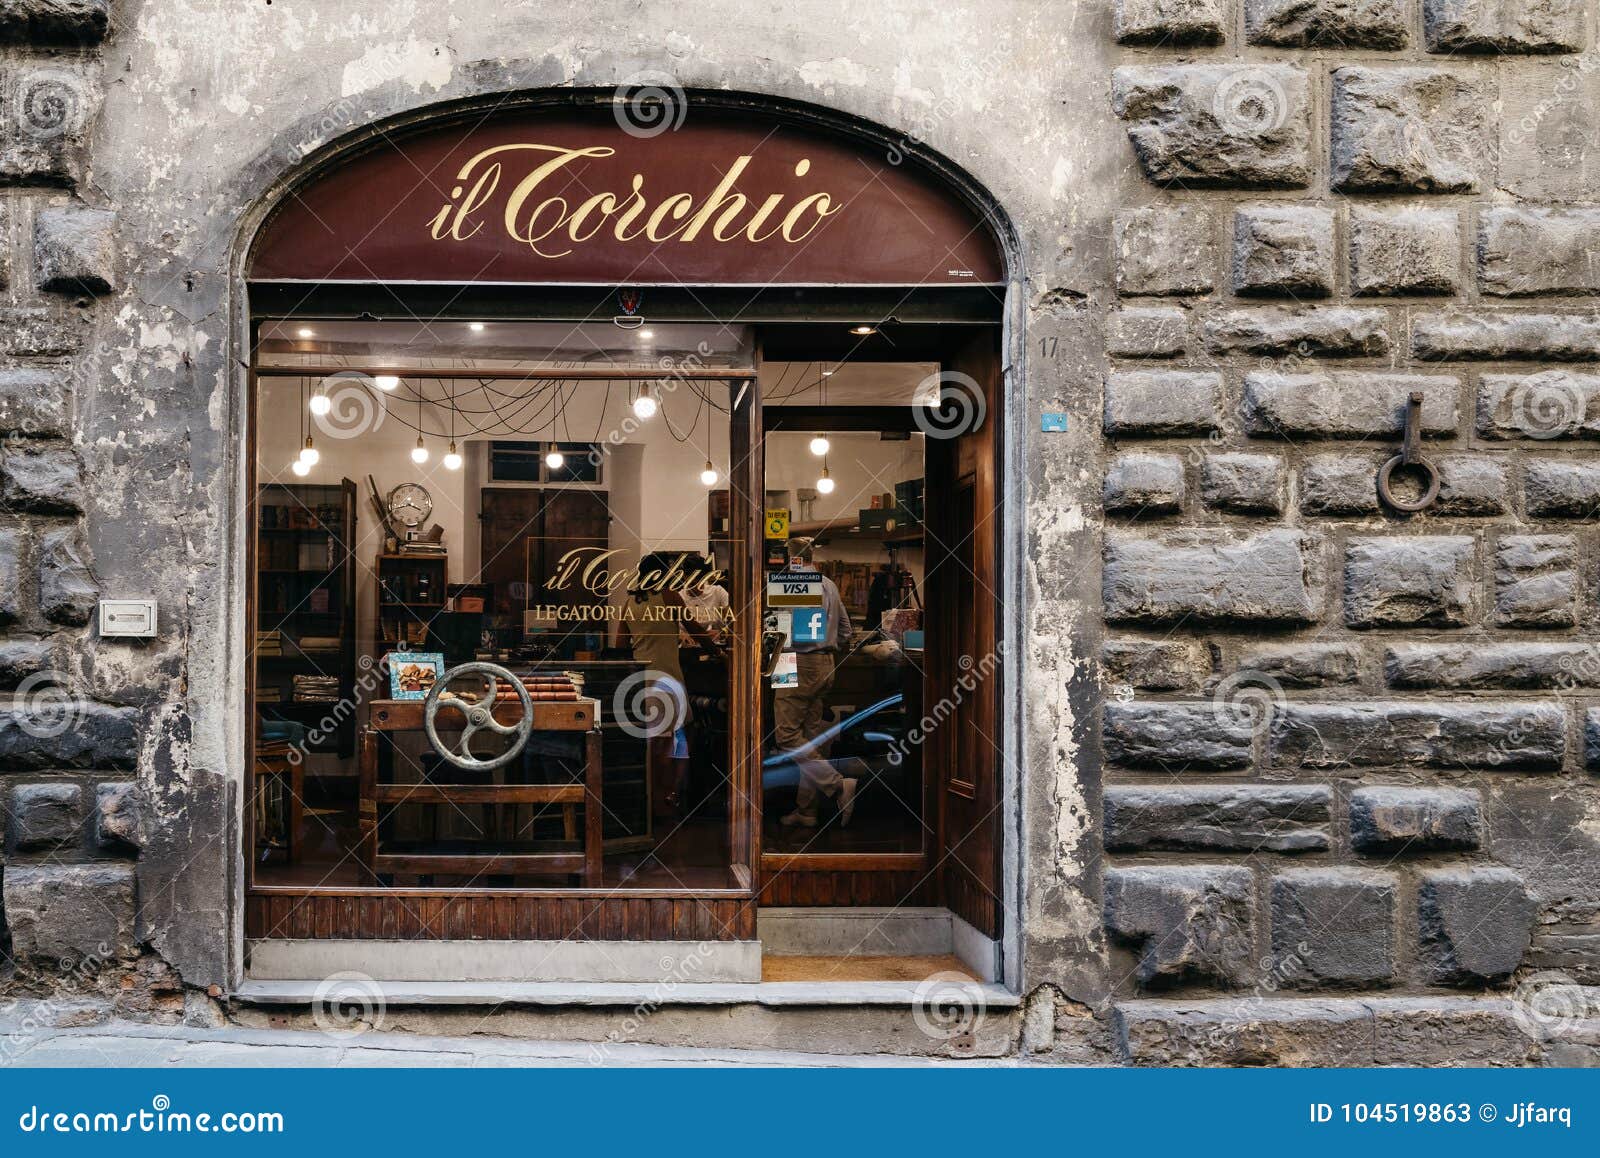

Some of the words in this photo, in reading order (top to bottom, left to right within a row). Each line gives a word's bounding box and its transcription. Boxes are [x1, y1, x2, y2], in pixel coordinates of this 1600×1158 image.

[426, 163, 501, 241] il
[457, 144, 842, 258] Torchio
[1039, 336, 1058, 358] 17
[542, 557, 581, 590] il
[783, 584, 809, 594] VISA
[536, 605, 635, 621] LEGATORIA
